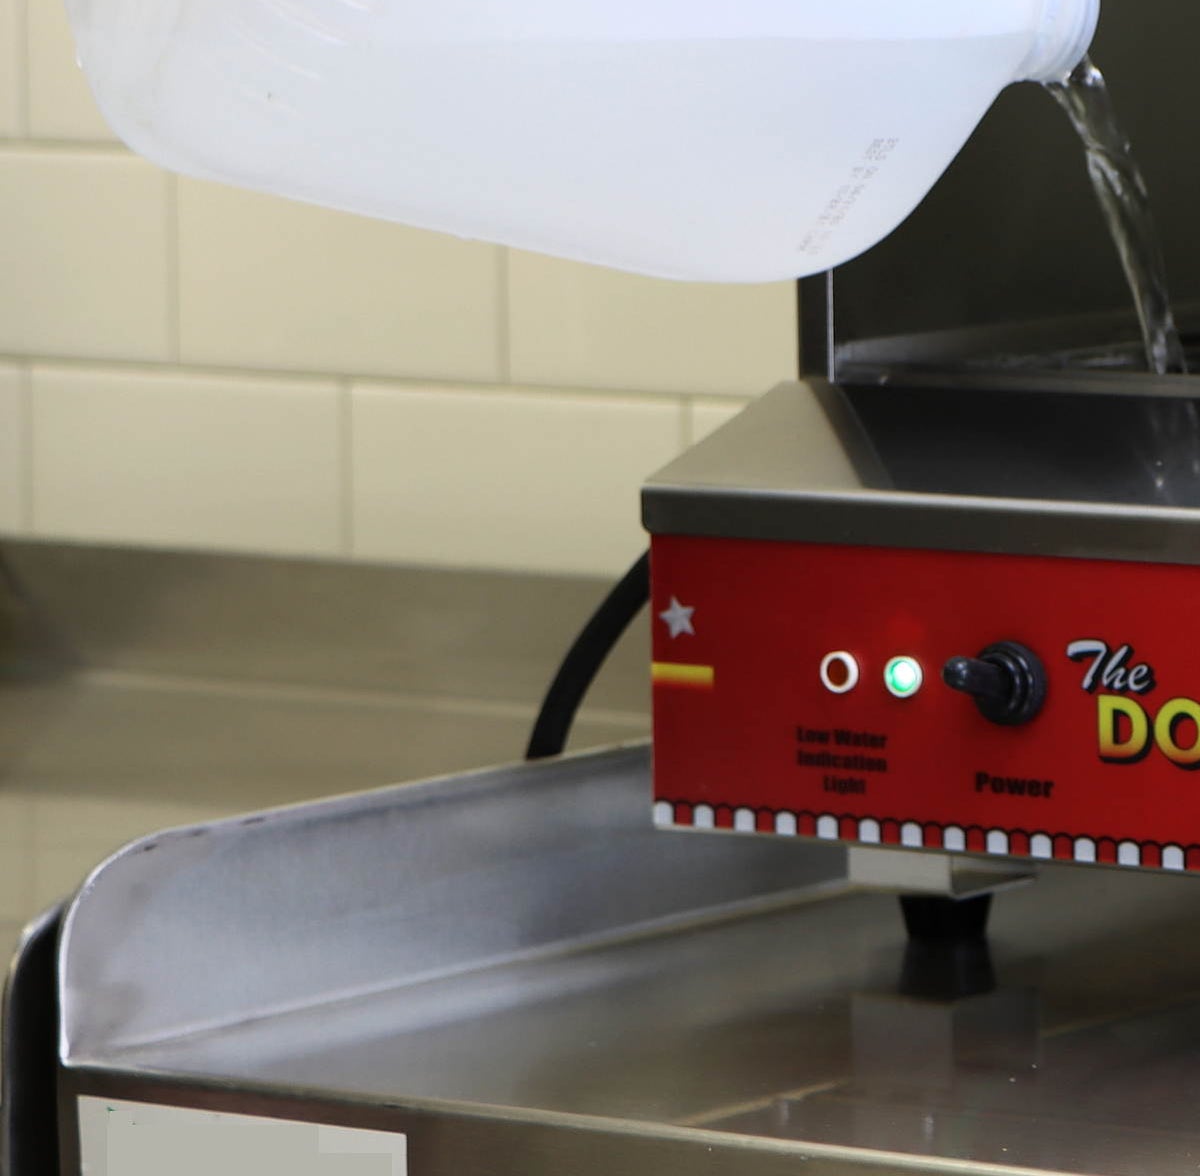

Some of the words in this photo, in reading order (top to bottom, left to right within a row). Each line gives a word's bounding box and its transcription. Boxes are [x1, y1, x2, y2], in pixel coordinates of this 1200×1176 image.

[1066, 638, 1156, 694] The
[796, 727, 829, 745] Low
[834, 728, 887, 750] Water
[796, 749, 887, 772] Indication
[823, 774, 867, 795] Light
[975, 771, 1055, 799] Power
